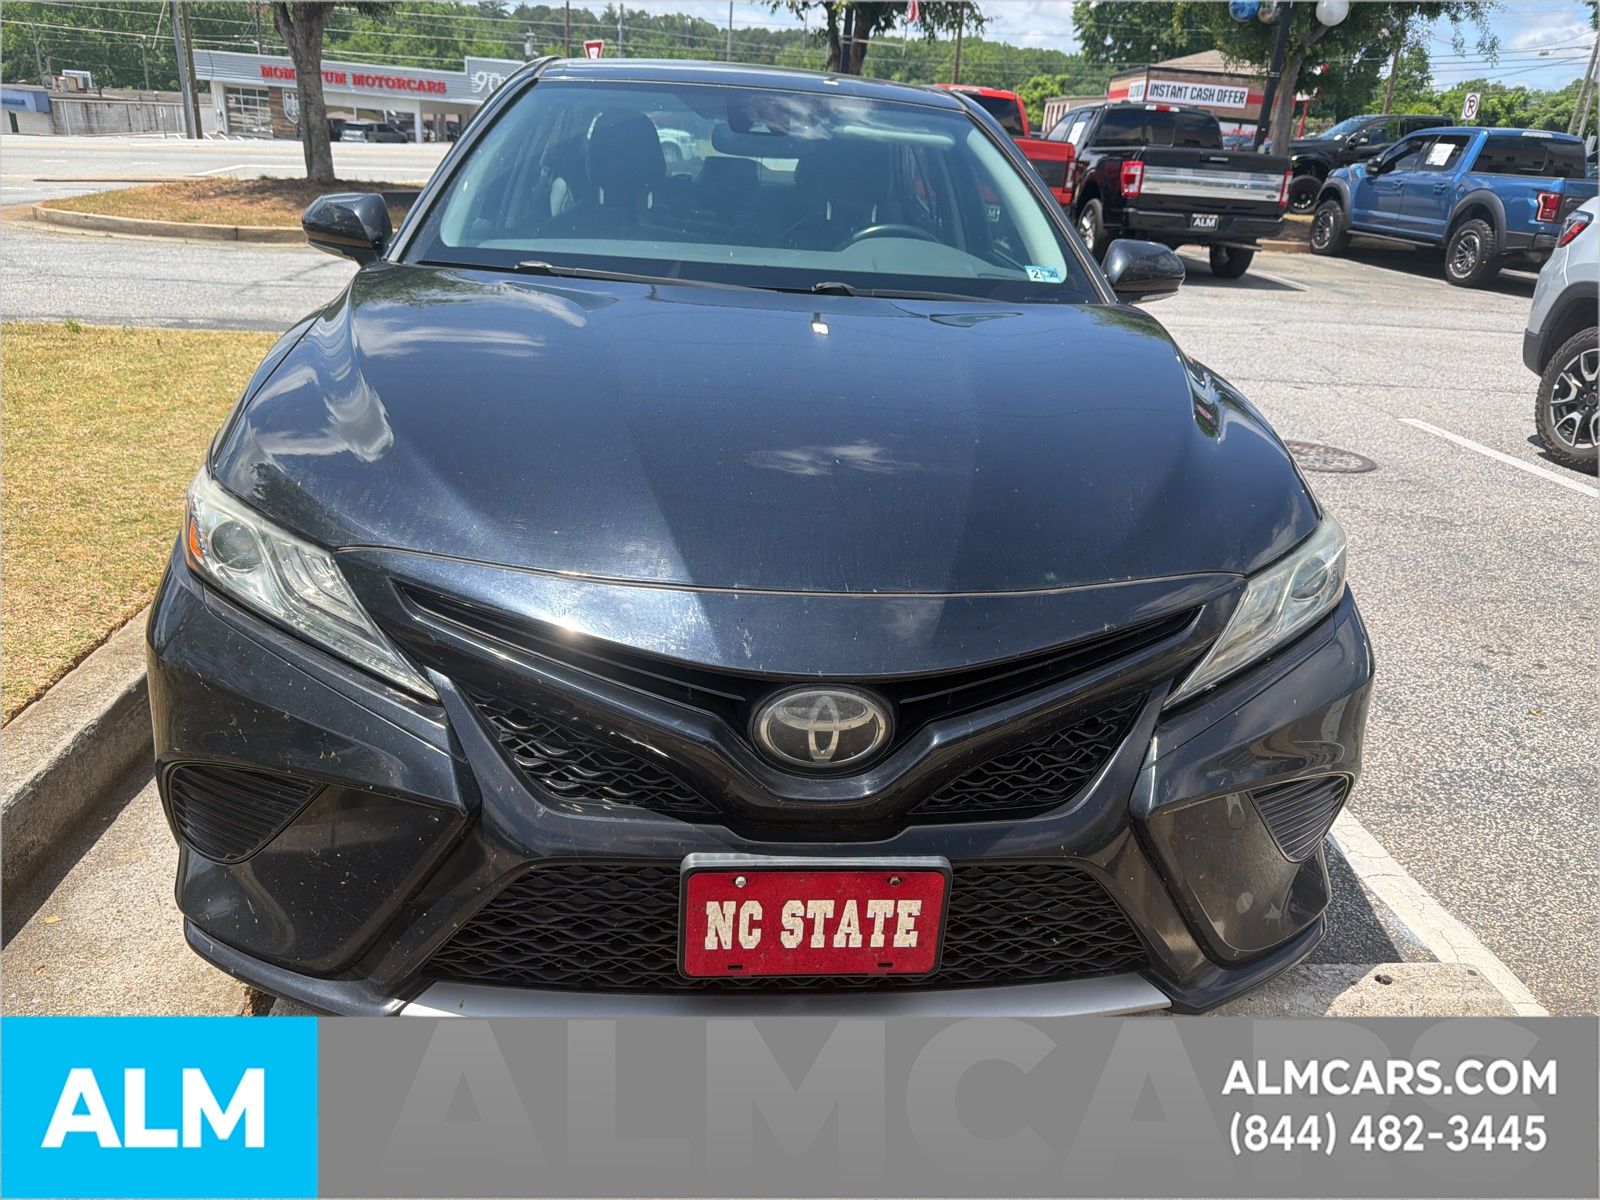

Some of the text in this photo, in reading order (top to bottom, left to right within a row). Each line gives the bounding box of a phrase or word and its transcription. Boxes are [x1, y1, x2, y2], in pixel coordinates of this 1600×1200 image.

[260, 65, 347, 85] MOMUM
[352, 73, 447, 95] MOTORCARS
[1149, 83, 1190, 100] INSTANT
[1190, 86, 1215, 103] CASH
[1216, 89, 1247, 104] OFFER
[1193, 217, 1216, 227] ALM
[704, 899, 922, 950] NC STATE
